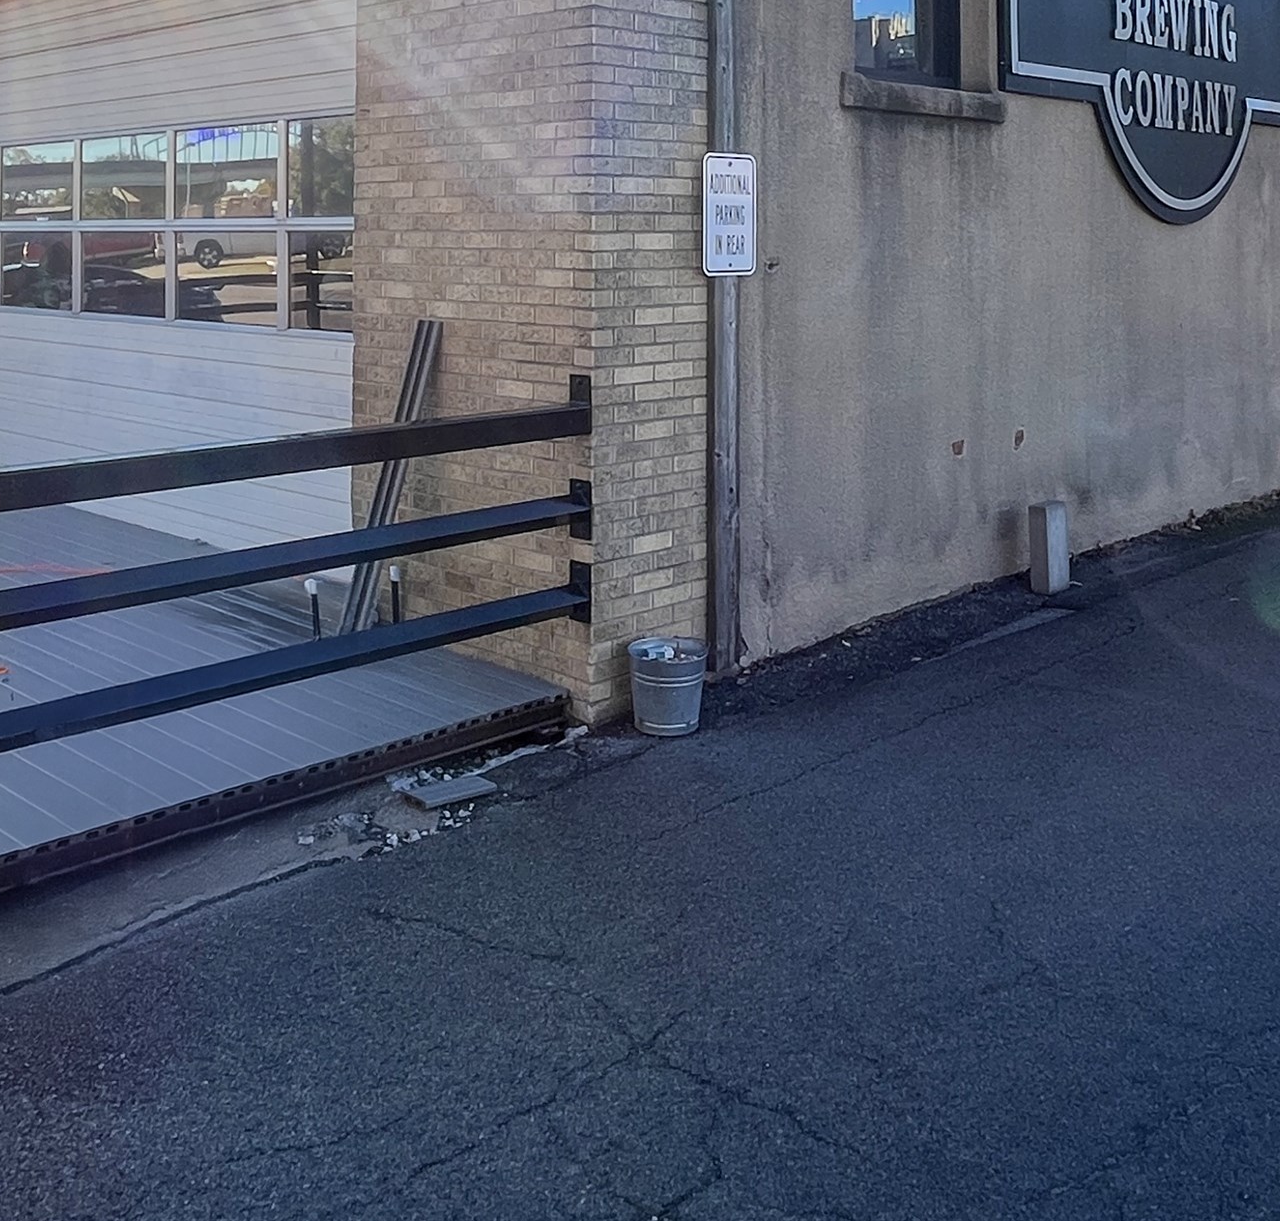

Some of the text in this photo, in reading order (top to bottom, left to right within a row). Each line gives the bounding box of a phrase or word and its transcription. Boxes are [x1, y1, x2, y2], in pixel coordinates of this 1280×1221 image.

[1114, 67, 1237, 136] COMPANY
[709, 173, 751, 195] ADDITIONAL
[715, 204, 746, 226] PARKING
[715, 234, 746, 255] IN REAR
